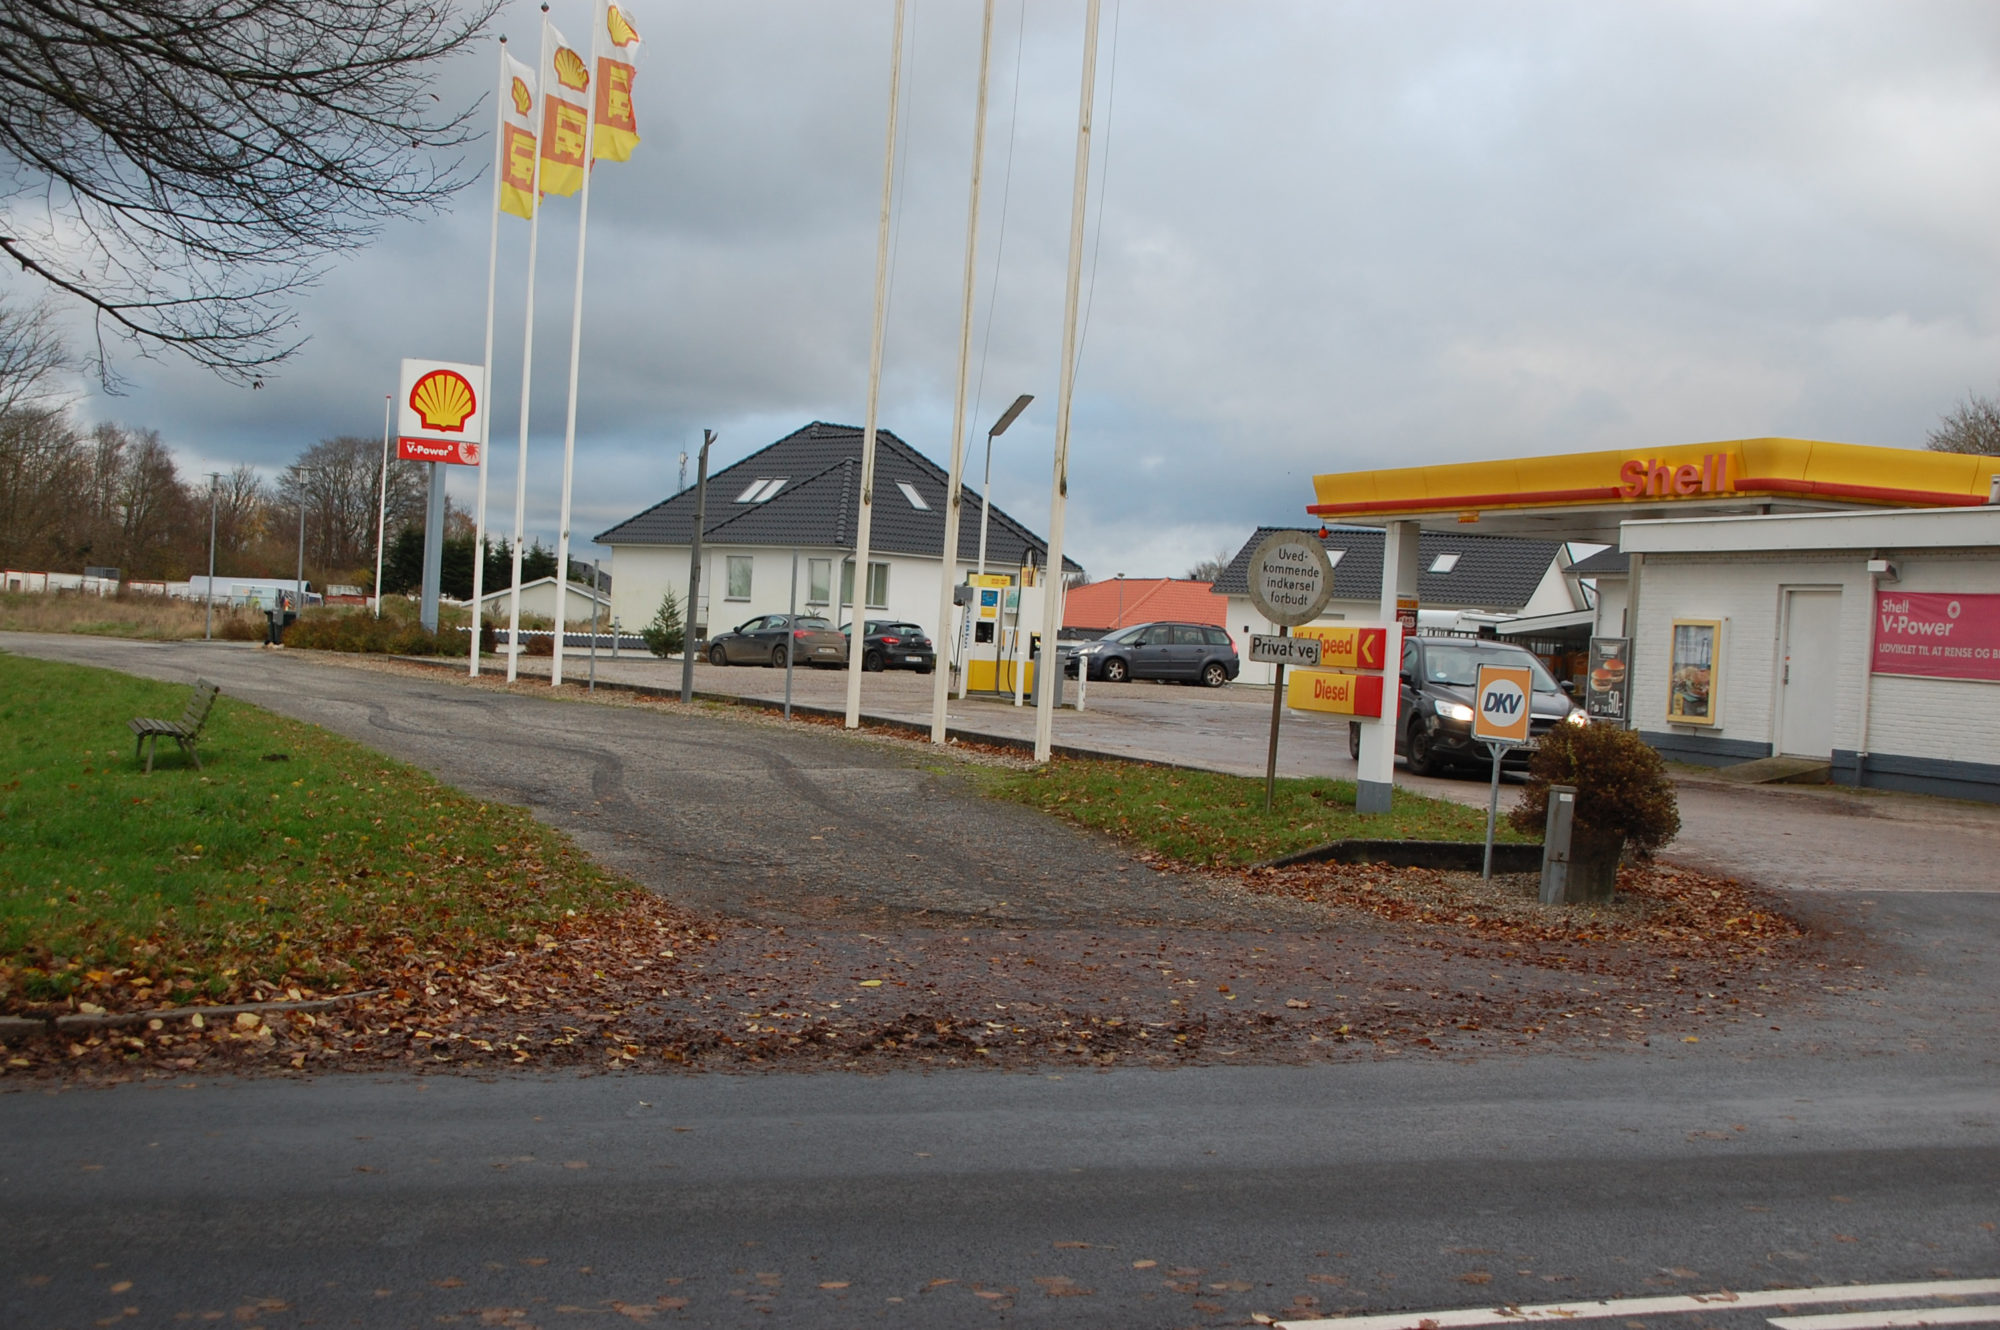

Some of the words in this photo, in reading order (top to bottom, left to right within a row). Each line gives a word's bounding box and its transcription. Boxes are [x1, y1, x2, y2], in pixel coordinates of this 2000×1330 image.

[406, 445, 448, 455] V-Power
[1619, 455, 1727, 496] Shell
[1278, 548, 1309, 562] Uved-
[1263, 561, 1320, 578] kommende
[1267, 577, 1315, 592] indkørsel
[1270, 592, 1308, 606] forbudt
[1881, 599, 1909, 613] Shell
[1881, 615, 1954, 636] V-Power
[1252, 637, 1294, 657] Privat
[1297, 643, 1319, 664] vej
[1879, 643, 1916, 654] UDVIKLET
[1918, 646, 1930, 656] TIL
[1932, 646, 1943, 656] AT
[1944, 647, 1973, 658] RENSE
[1975, 648, 1990, 659] OG
[1314, 679, 1350, 702] Diesel
[1483, 692, 1523, 714] DKV
